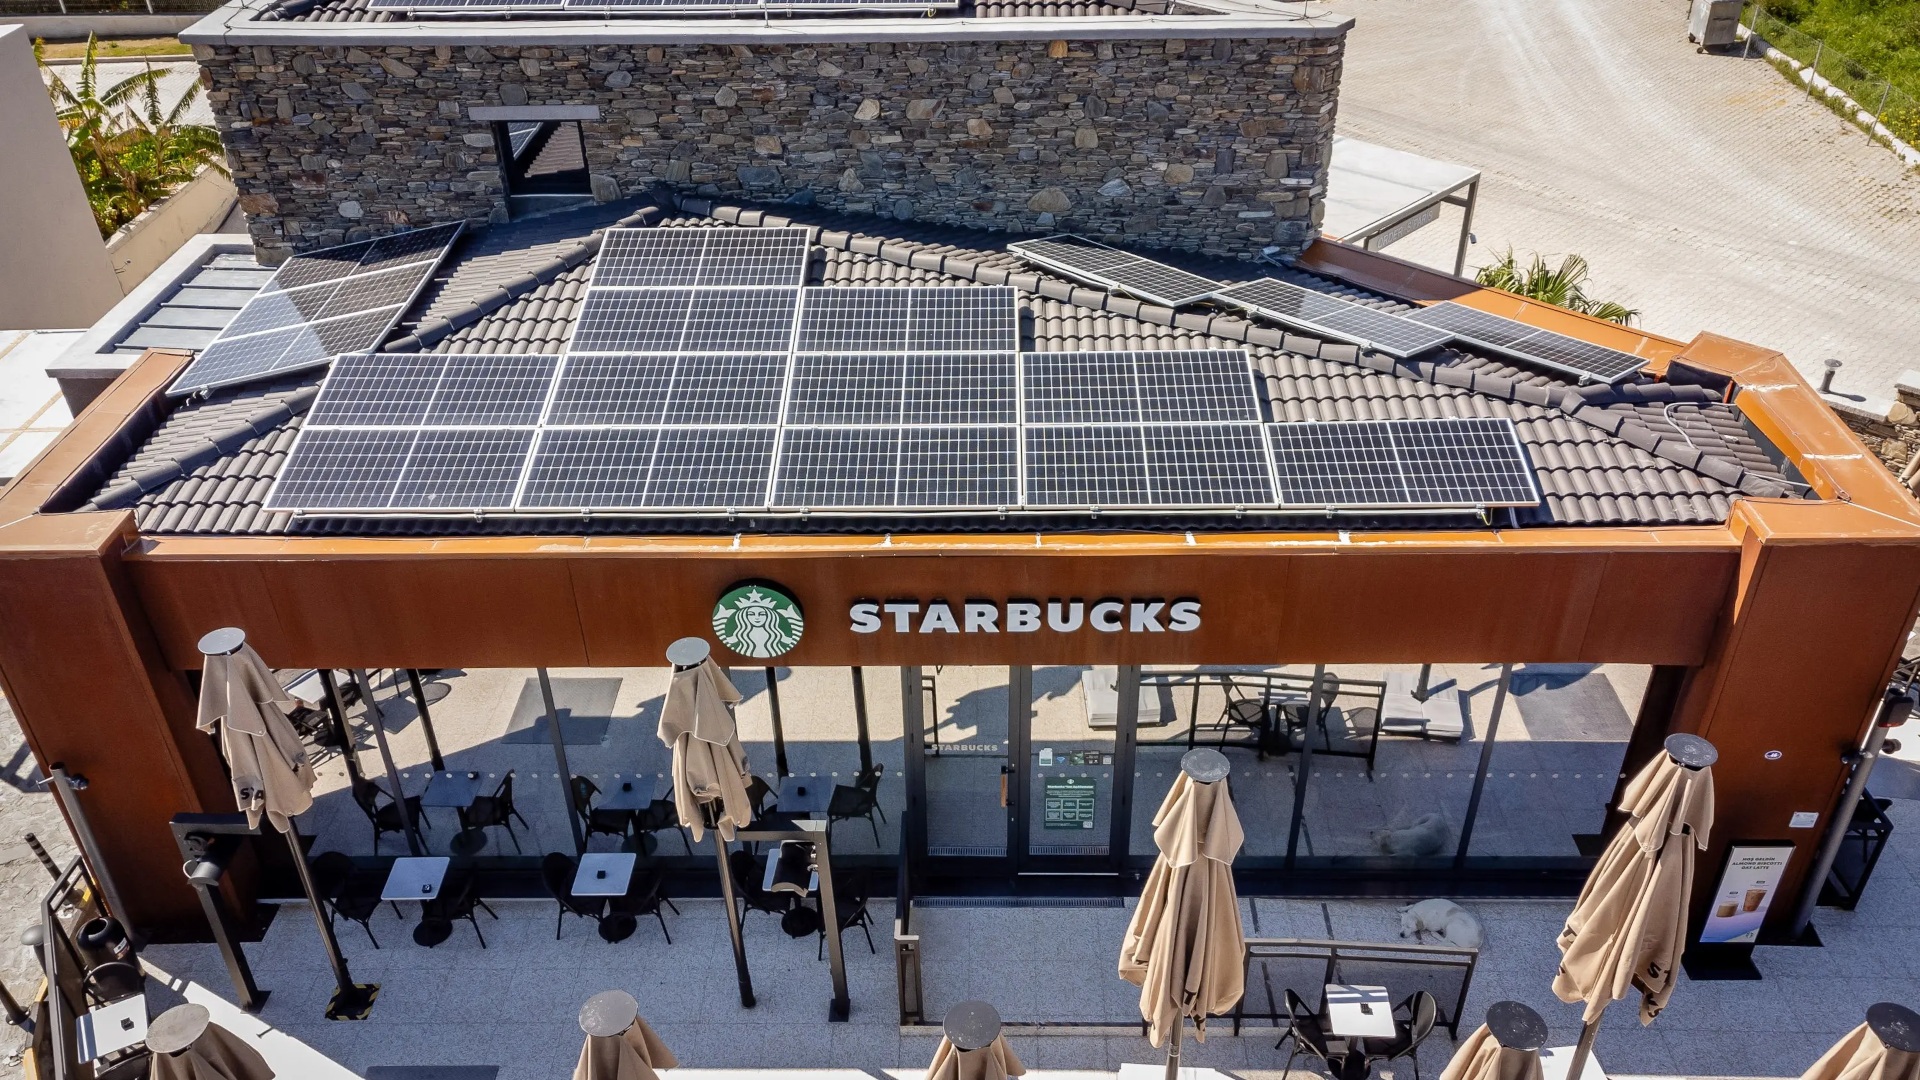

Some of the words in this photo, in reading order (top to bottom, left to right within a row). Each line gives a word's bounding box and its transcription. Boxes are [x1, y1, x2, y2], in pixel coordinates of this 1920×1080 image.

[1377, 226, 1403, 249] ORDER
[850, 601, 1202, 633] STARBUCKS
[931, 743, 998, 751] STARBUCKS
